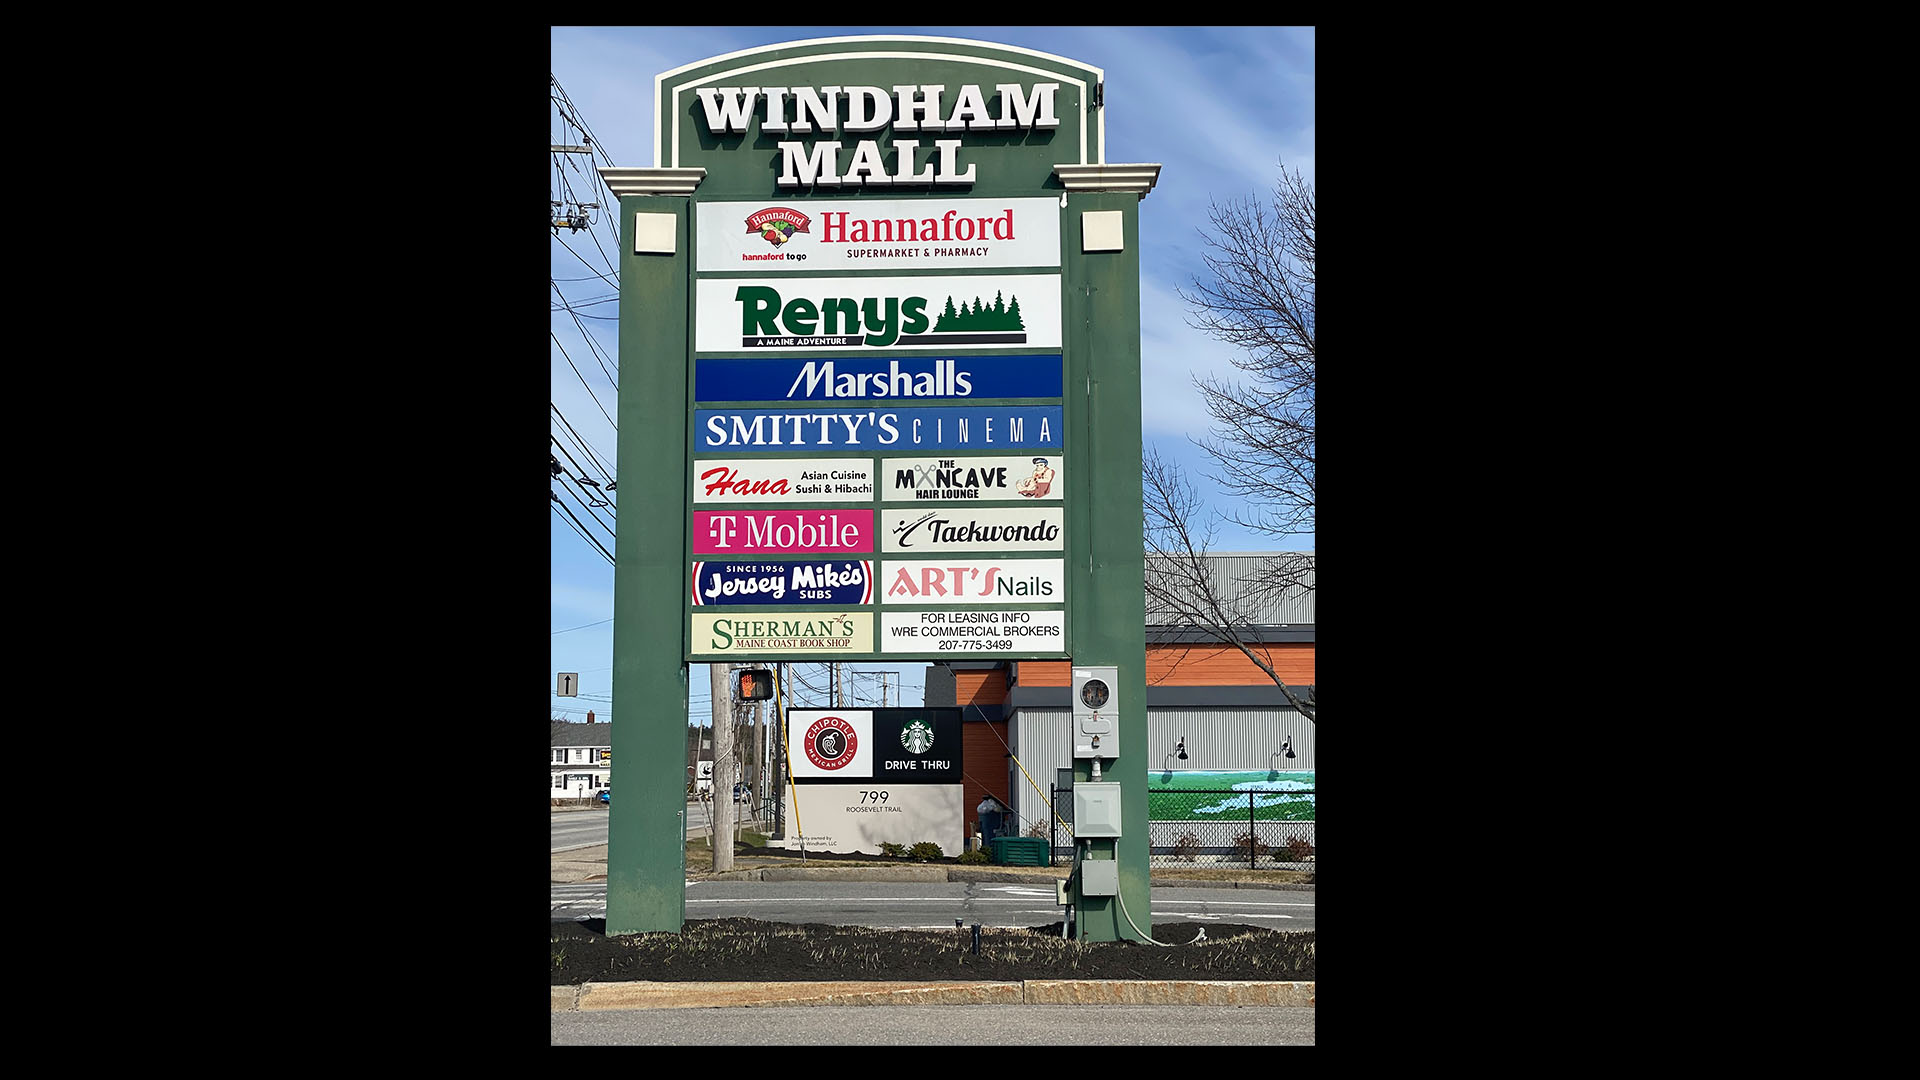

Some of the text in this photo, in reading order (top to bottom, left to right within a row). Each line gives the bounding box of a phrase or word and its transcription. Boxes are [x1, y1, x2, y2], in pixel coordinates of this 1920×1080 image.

[696, 83, 1060, 133] WINDHAM
[777, 140, 976, 187] MALL
[752, 211, 805, 226] Hannaford
[820, 209, 1015, 243] Hannaford
[742, 253, 784, 261] hannaford
[847, 247, 989, 258] SUPERMARKET & PHARMACY
[735, 286, 929, 346] Renys
[796, 337, 847, 345] ADVENTURE
[787, 360, 973, 398] Marshalls
[705, 412, 1051, 447] SMITTY'S CINEMA
[938, 460, 955, 468] THE
[701, 467, 792, 496] Hana
[801, 470, 867, 480] Asian Cuisine
[895, 466, 1007, 489] MNCAVE
[795, 484, 872, 494] Sushi & Hibachi
[915, 489, 979, 499] HAIR LOUNGE
[744, 515, 859, 548] Mobile
[927, 519, 1060, 543] Taekwondo
[726, 565, 757, 573] SINCE
[705, 563, 863, 599] Jersey Mike's
[888, 567, 1053, 597] ART'S Nails
[800, 590, 832, 599] SUBS
[921, 612, 1030, 623] FOR LEASING INFO
[891, 626, 1060, 637] WRE COMMERCIAL BROKERS
[736, 639, 850, 648] MAINE COAST BOOK SHOP
[939, 640, 1012, 650] 207-775-3499
[807, 719, 855, 740] CHIPOTLE
[808, 748, 854, 767] MEXICAN GRILL
[885, 760, 950, 770] DRIVE THRU
[859, 791, 889, 804] 799
